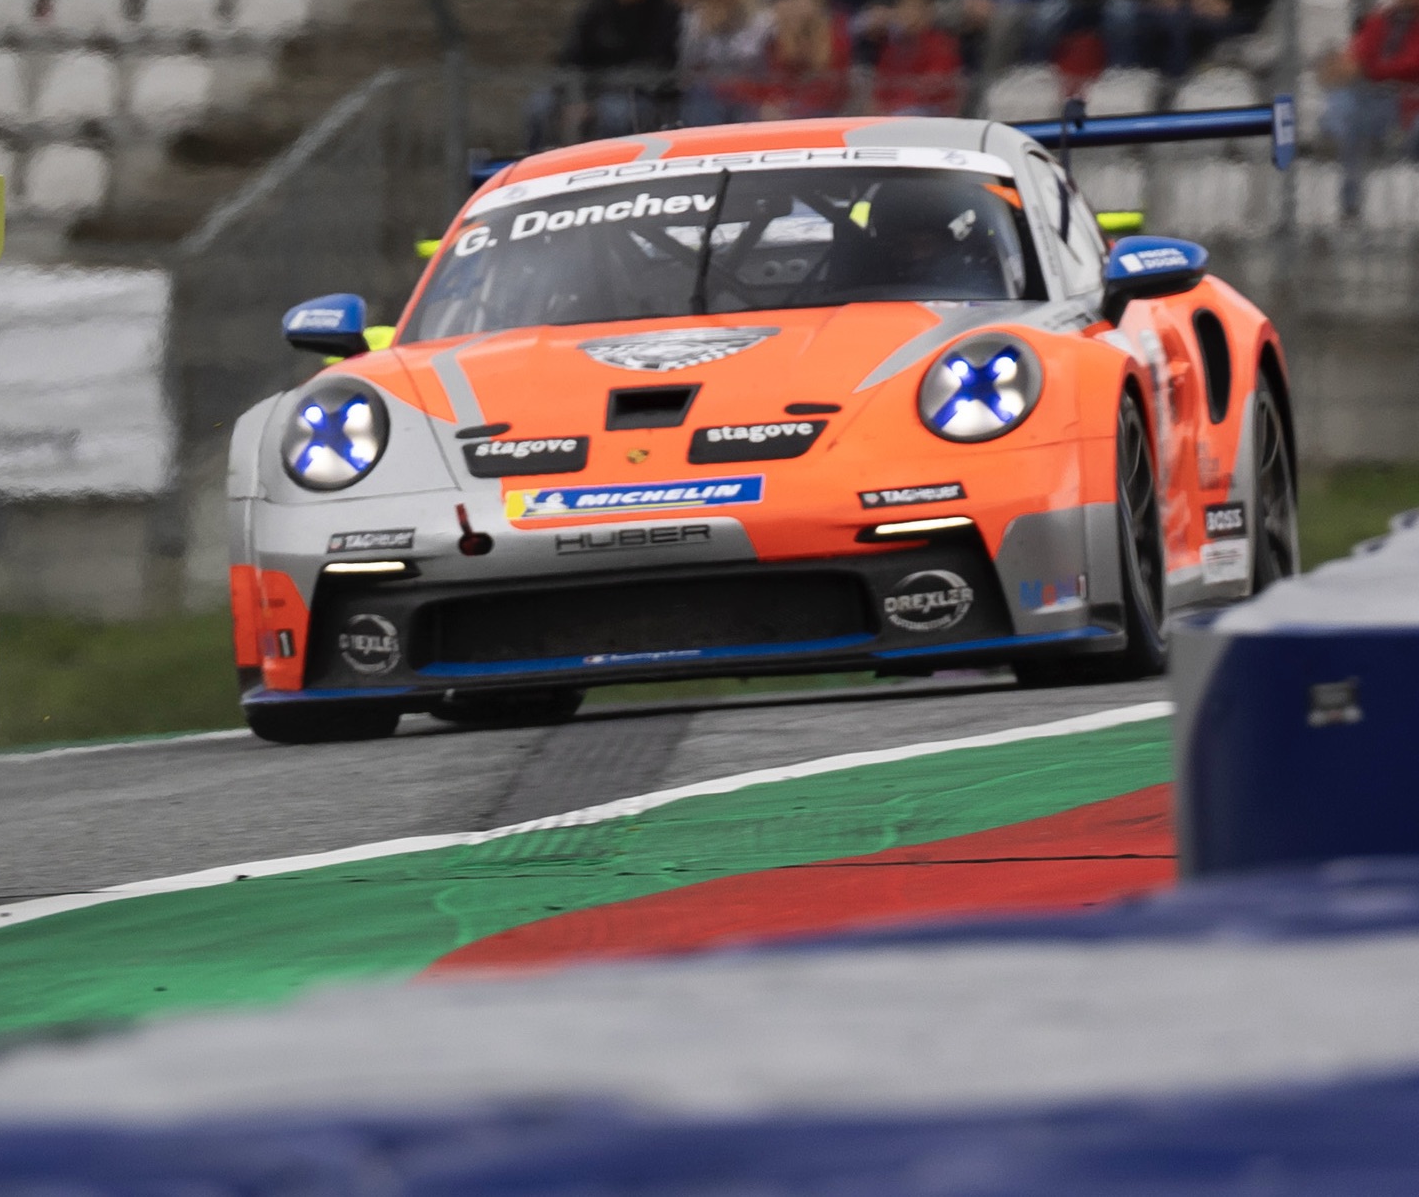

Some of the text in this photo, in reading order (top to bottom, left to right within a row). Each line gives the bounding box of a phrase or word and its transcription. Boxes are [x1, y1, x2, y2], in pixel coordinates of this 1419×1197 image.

[566, 148, 899, 186] PORSCHE
[454, 192, 718, 257] G. Donchev
[706, 422, 813, 444] stagove
[475, 437, 578, 459] stagove
[575, 483, 743, 508] MICHELIN
[555, 524, 711, 552] HUBER
[884, 588, 974, 612] DREXLER
